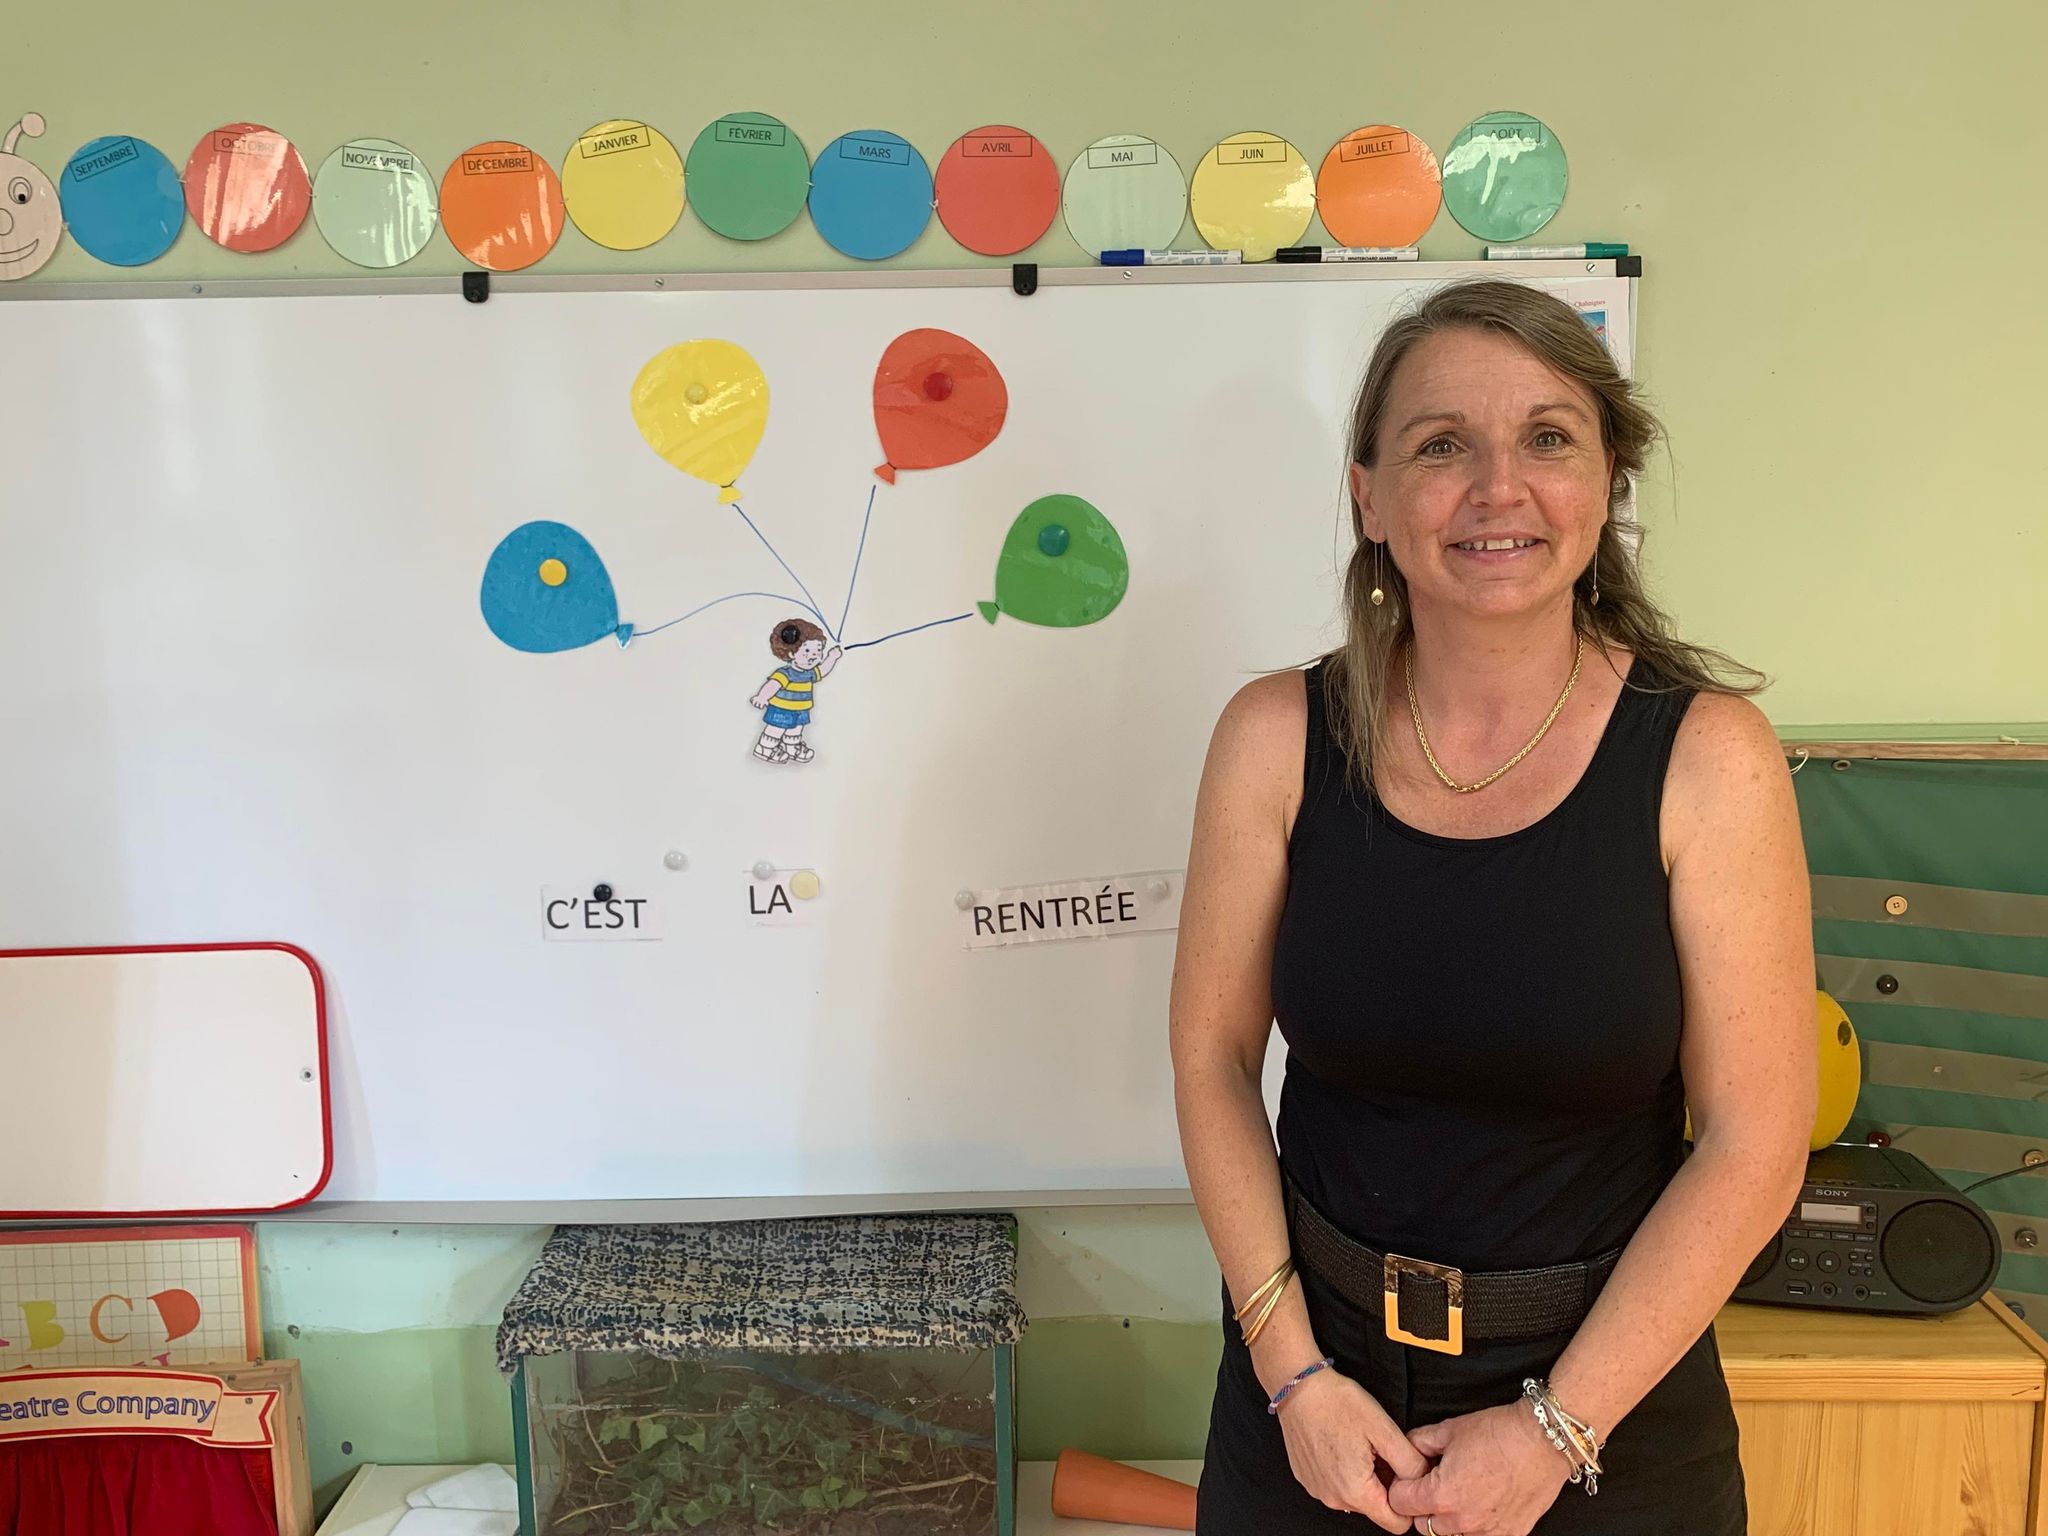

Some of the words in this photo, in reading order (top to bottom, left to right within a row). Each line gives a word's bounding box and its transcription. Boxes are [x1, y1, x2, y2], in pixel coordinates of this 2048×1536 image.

[728, 126, 773, 142] FÉVRIER
[221, 138, 277, 153] OCTOBRE
[592, 133, 639, 153] JANVIER
[981, 141, 1014, 153] AVRIL
[1355, 139, 1394, 156] JUILLET
[858, 144, 892, 159] MARS
[1111, 150, 1134, 163] MAI
[1239, 148, 1264, 161] JUIN
[75, 144, 134, 176] SEPTEMBRE
[467, 155, 529, 171] DÉCEMBRE
[749, 884, 793, 916] LA
[972, 886, 1138, 936] RENTRÉE
[1815, 1189, 1850, 1197] SONY
[76, 1390, 217, 1424] Company
